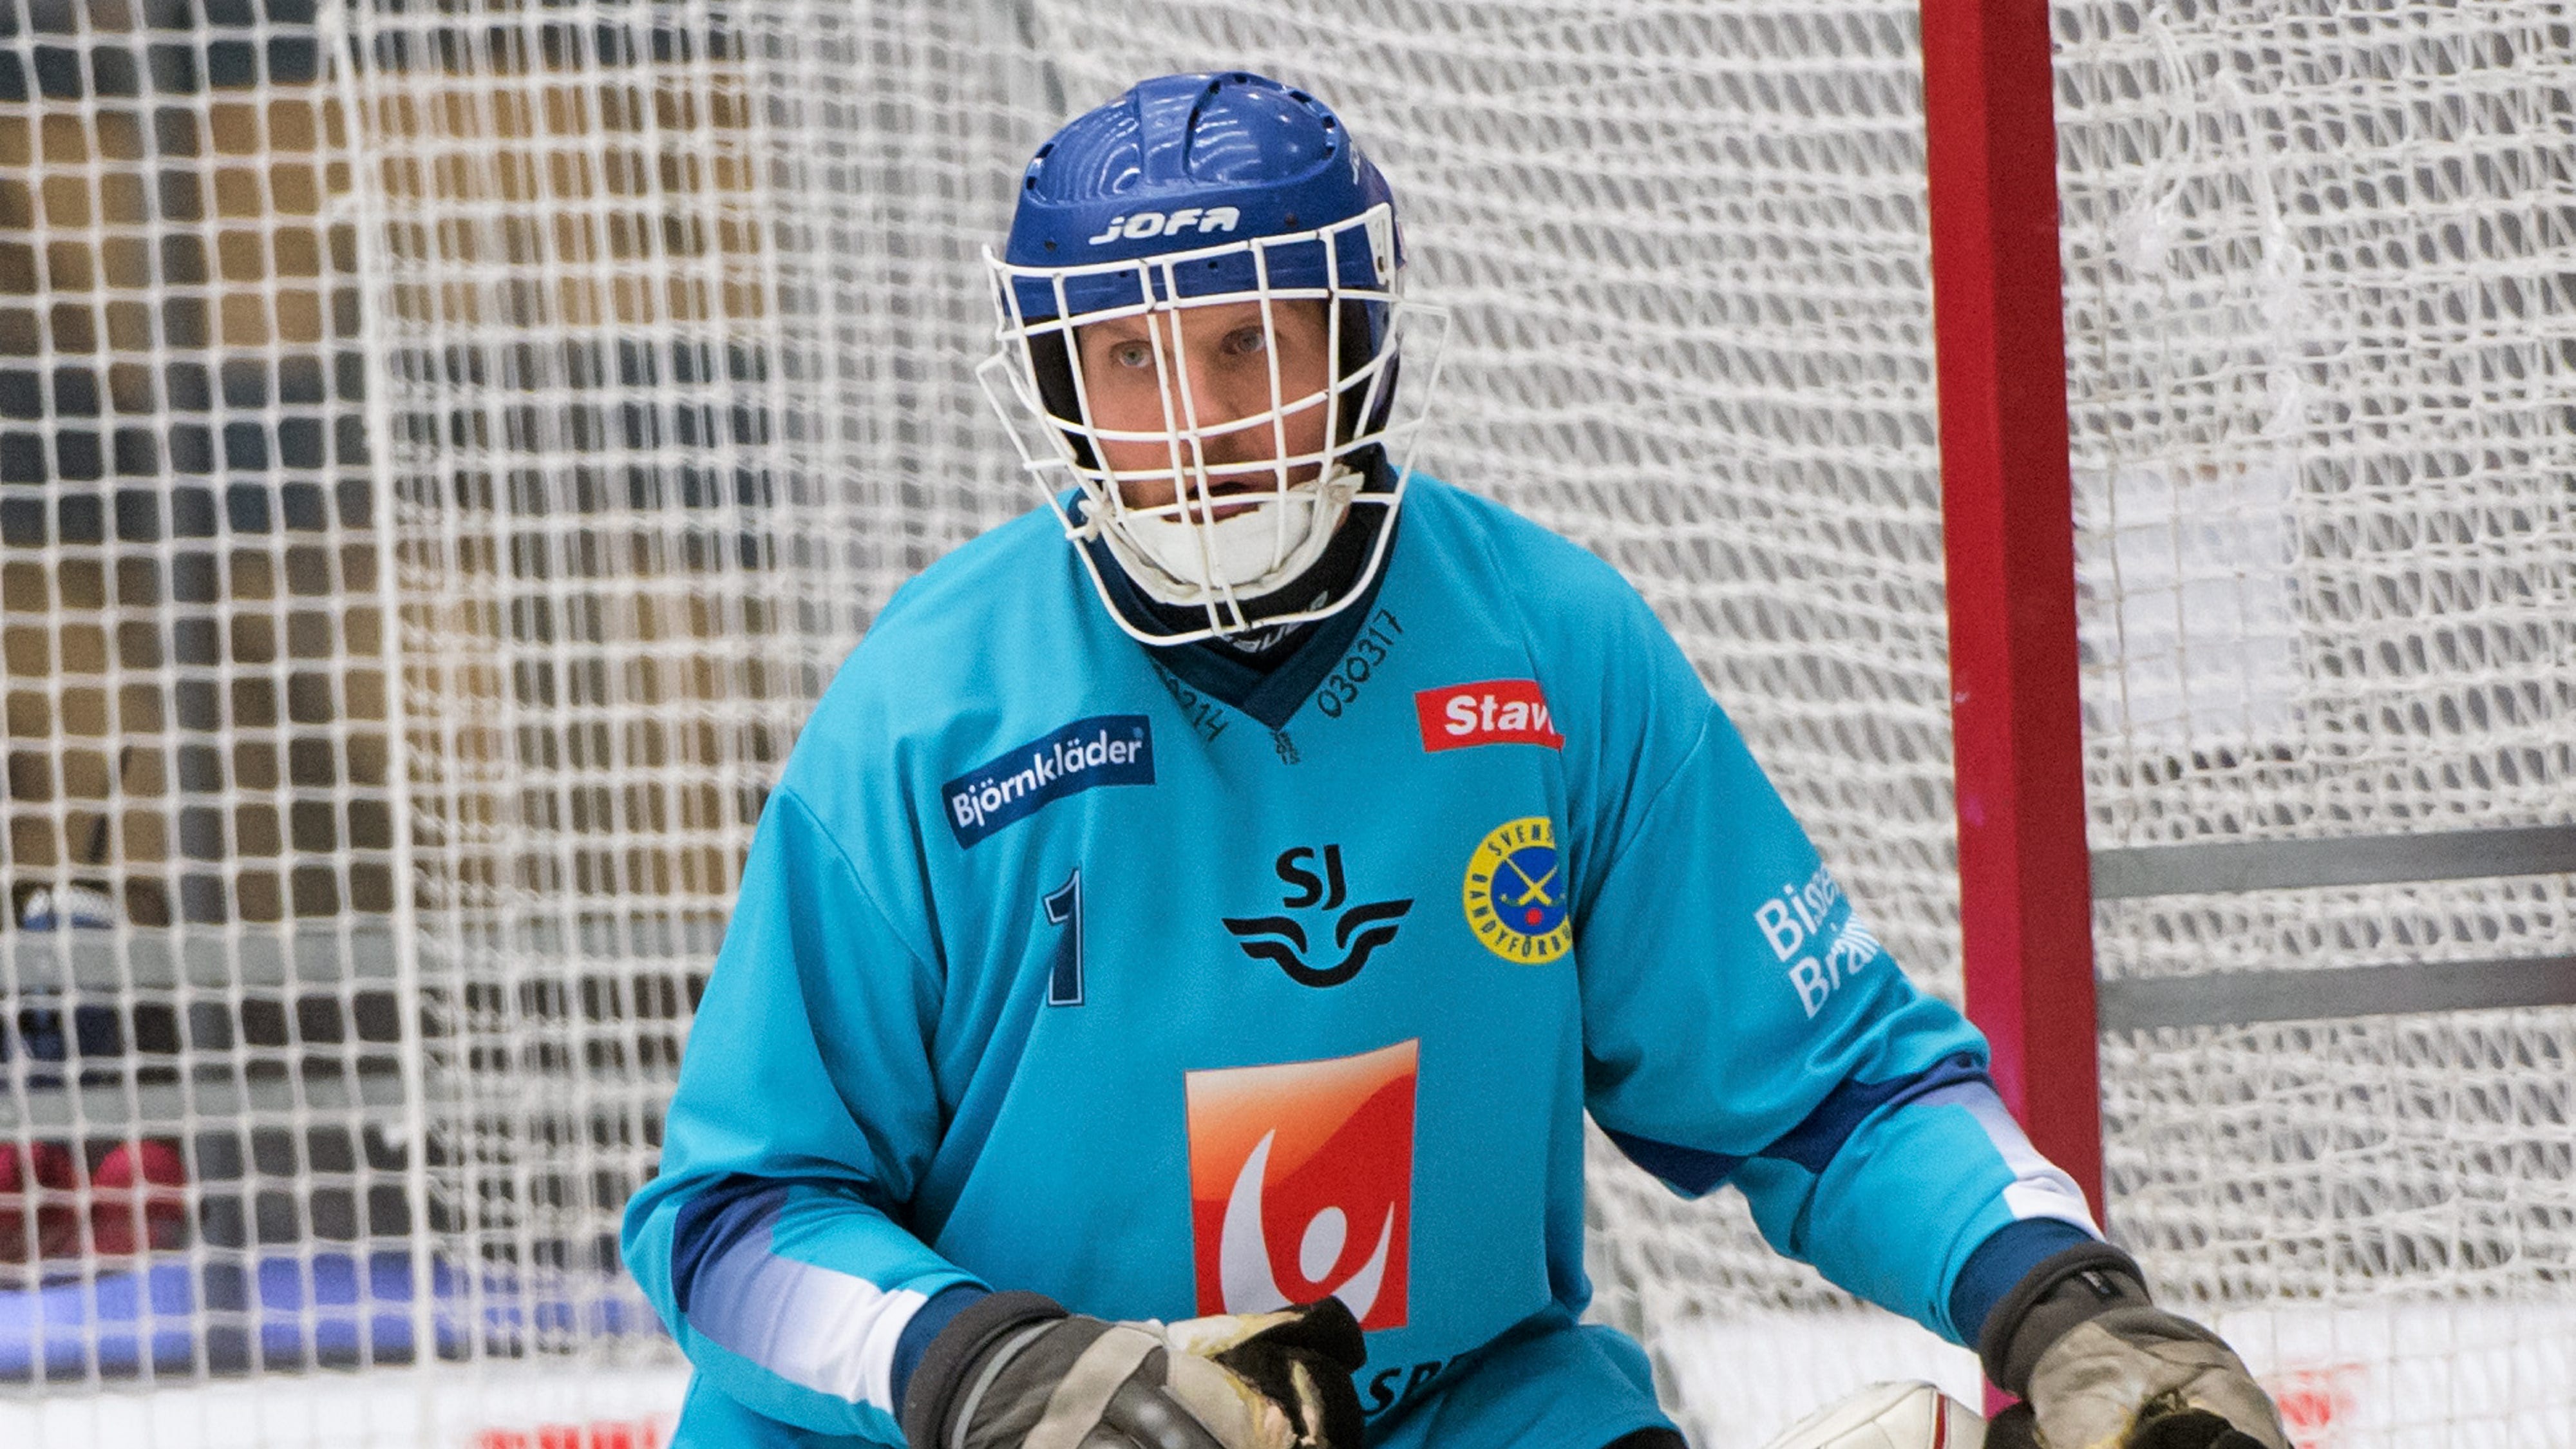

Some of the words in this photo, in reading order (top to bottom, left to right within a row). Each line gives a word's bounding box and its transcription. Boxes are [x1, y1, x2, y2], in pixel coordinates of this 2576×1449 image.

[1318, 608, 1403, 719] 030317
[952, 729, 1143, 828] Björnkläder
[1275, 844, 1347, 911] SJ
[1041, 866, 1084, 1006] 1
